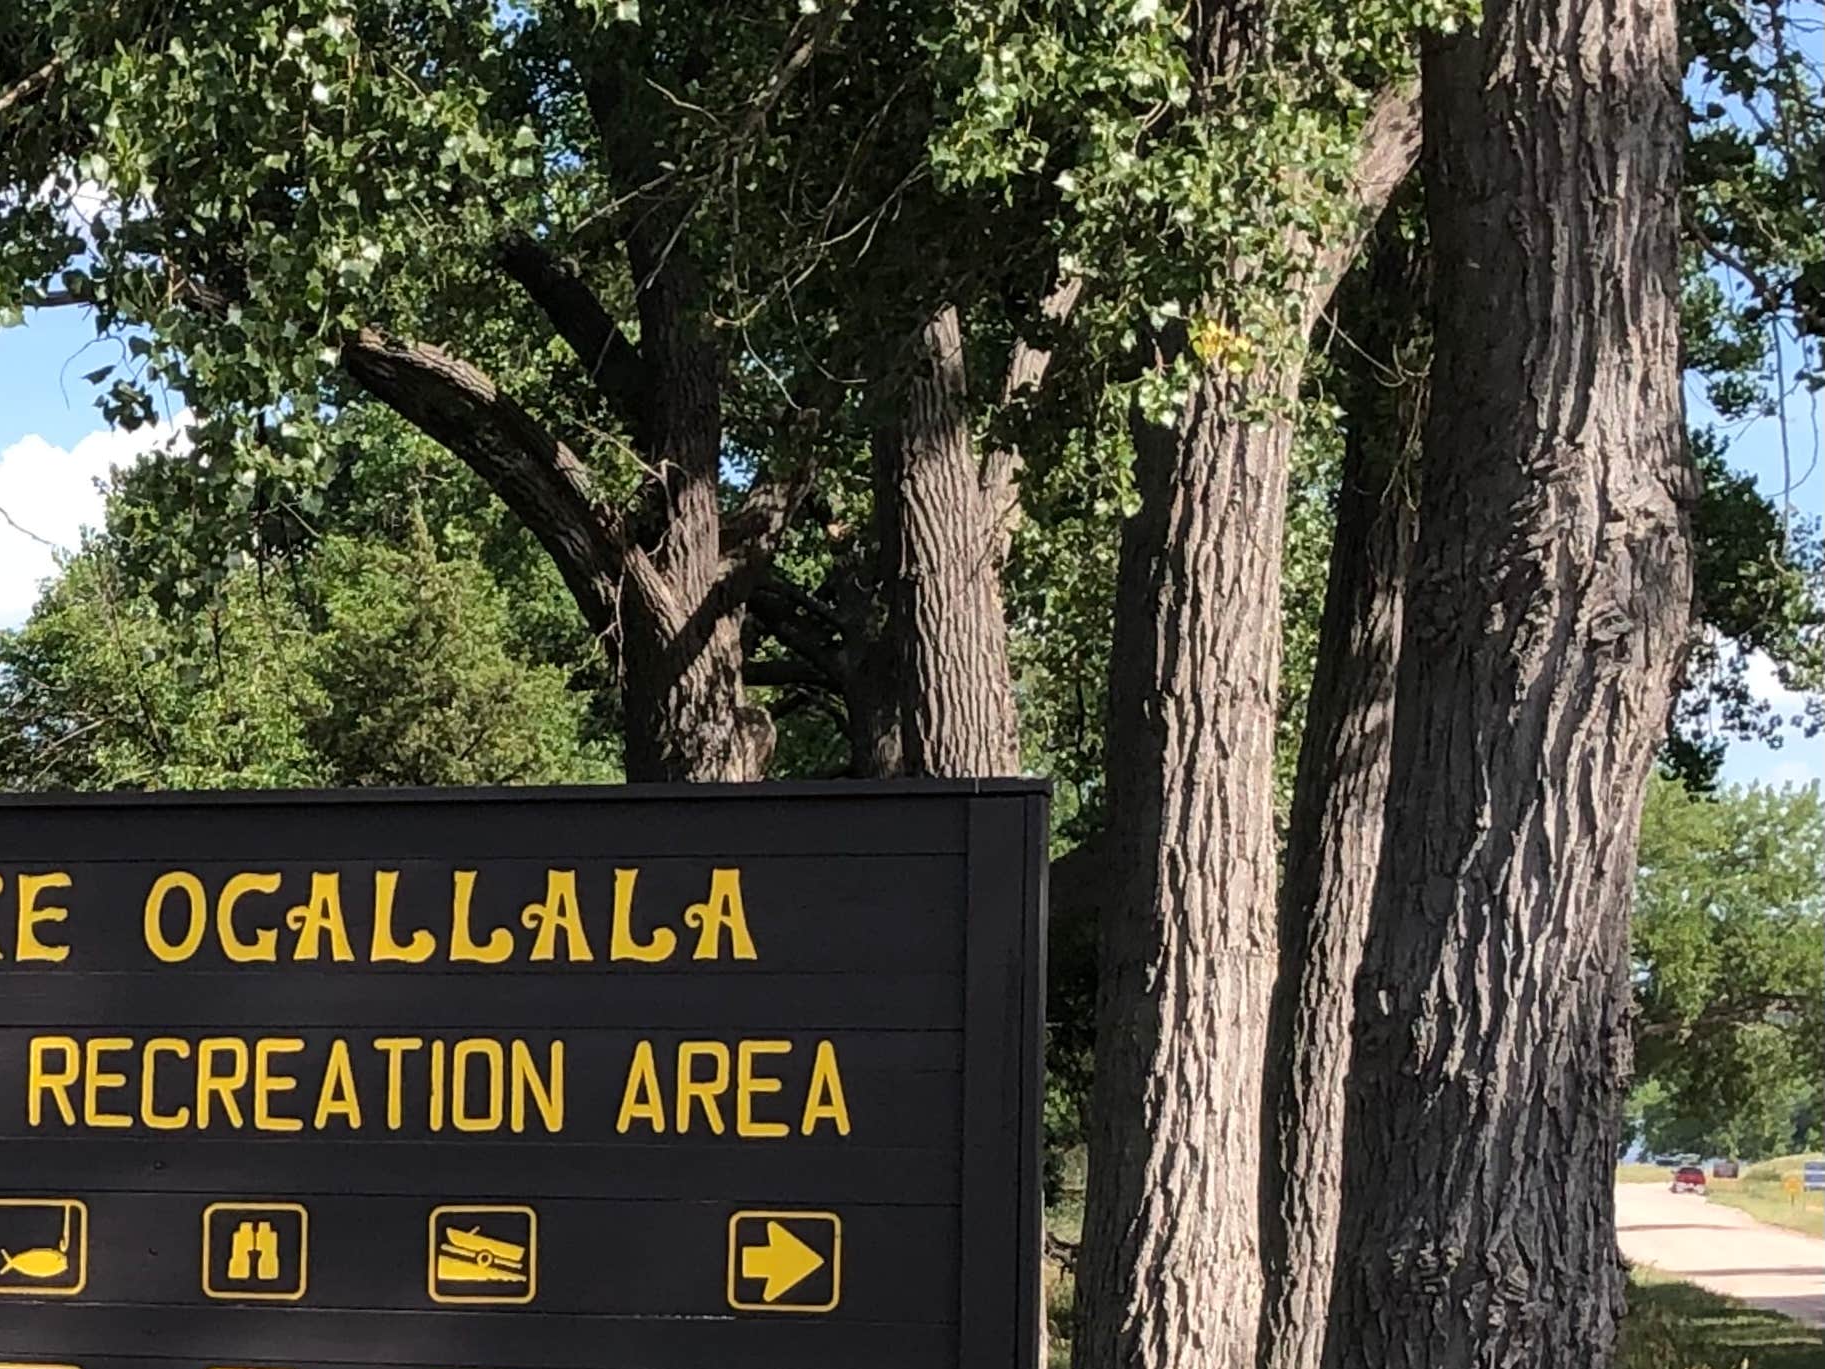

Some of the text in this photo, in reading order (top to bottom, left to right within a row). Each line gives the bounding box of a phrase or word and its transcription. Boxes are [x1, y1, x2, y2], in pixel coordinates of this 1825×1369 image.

[143, 867, 759, 964] OGALLALA
[27, 1034, 565, 1134] RECREATION
[615, 1038, 852, 1139] AREA
